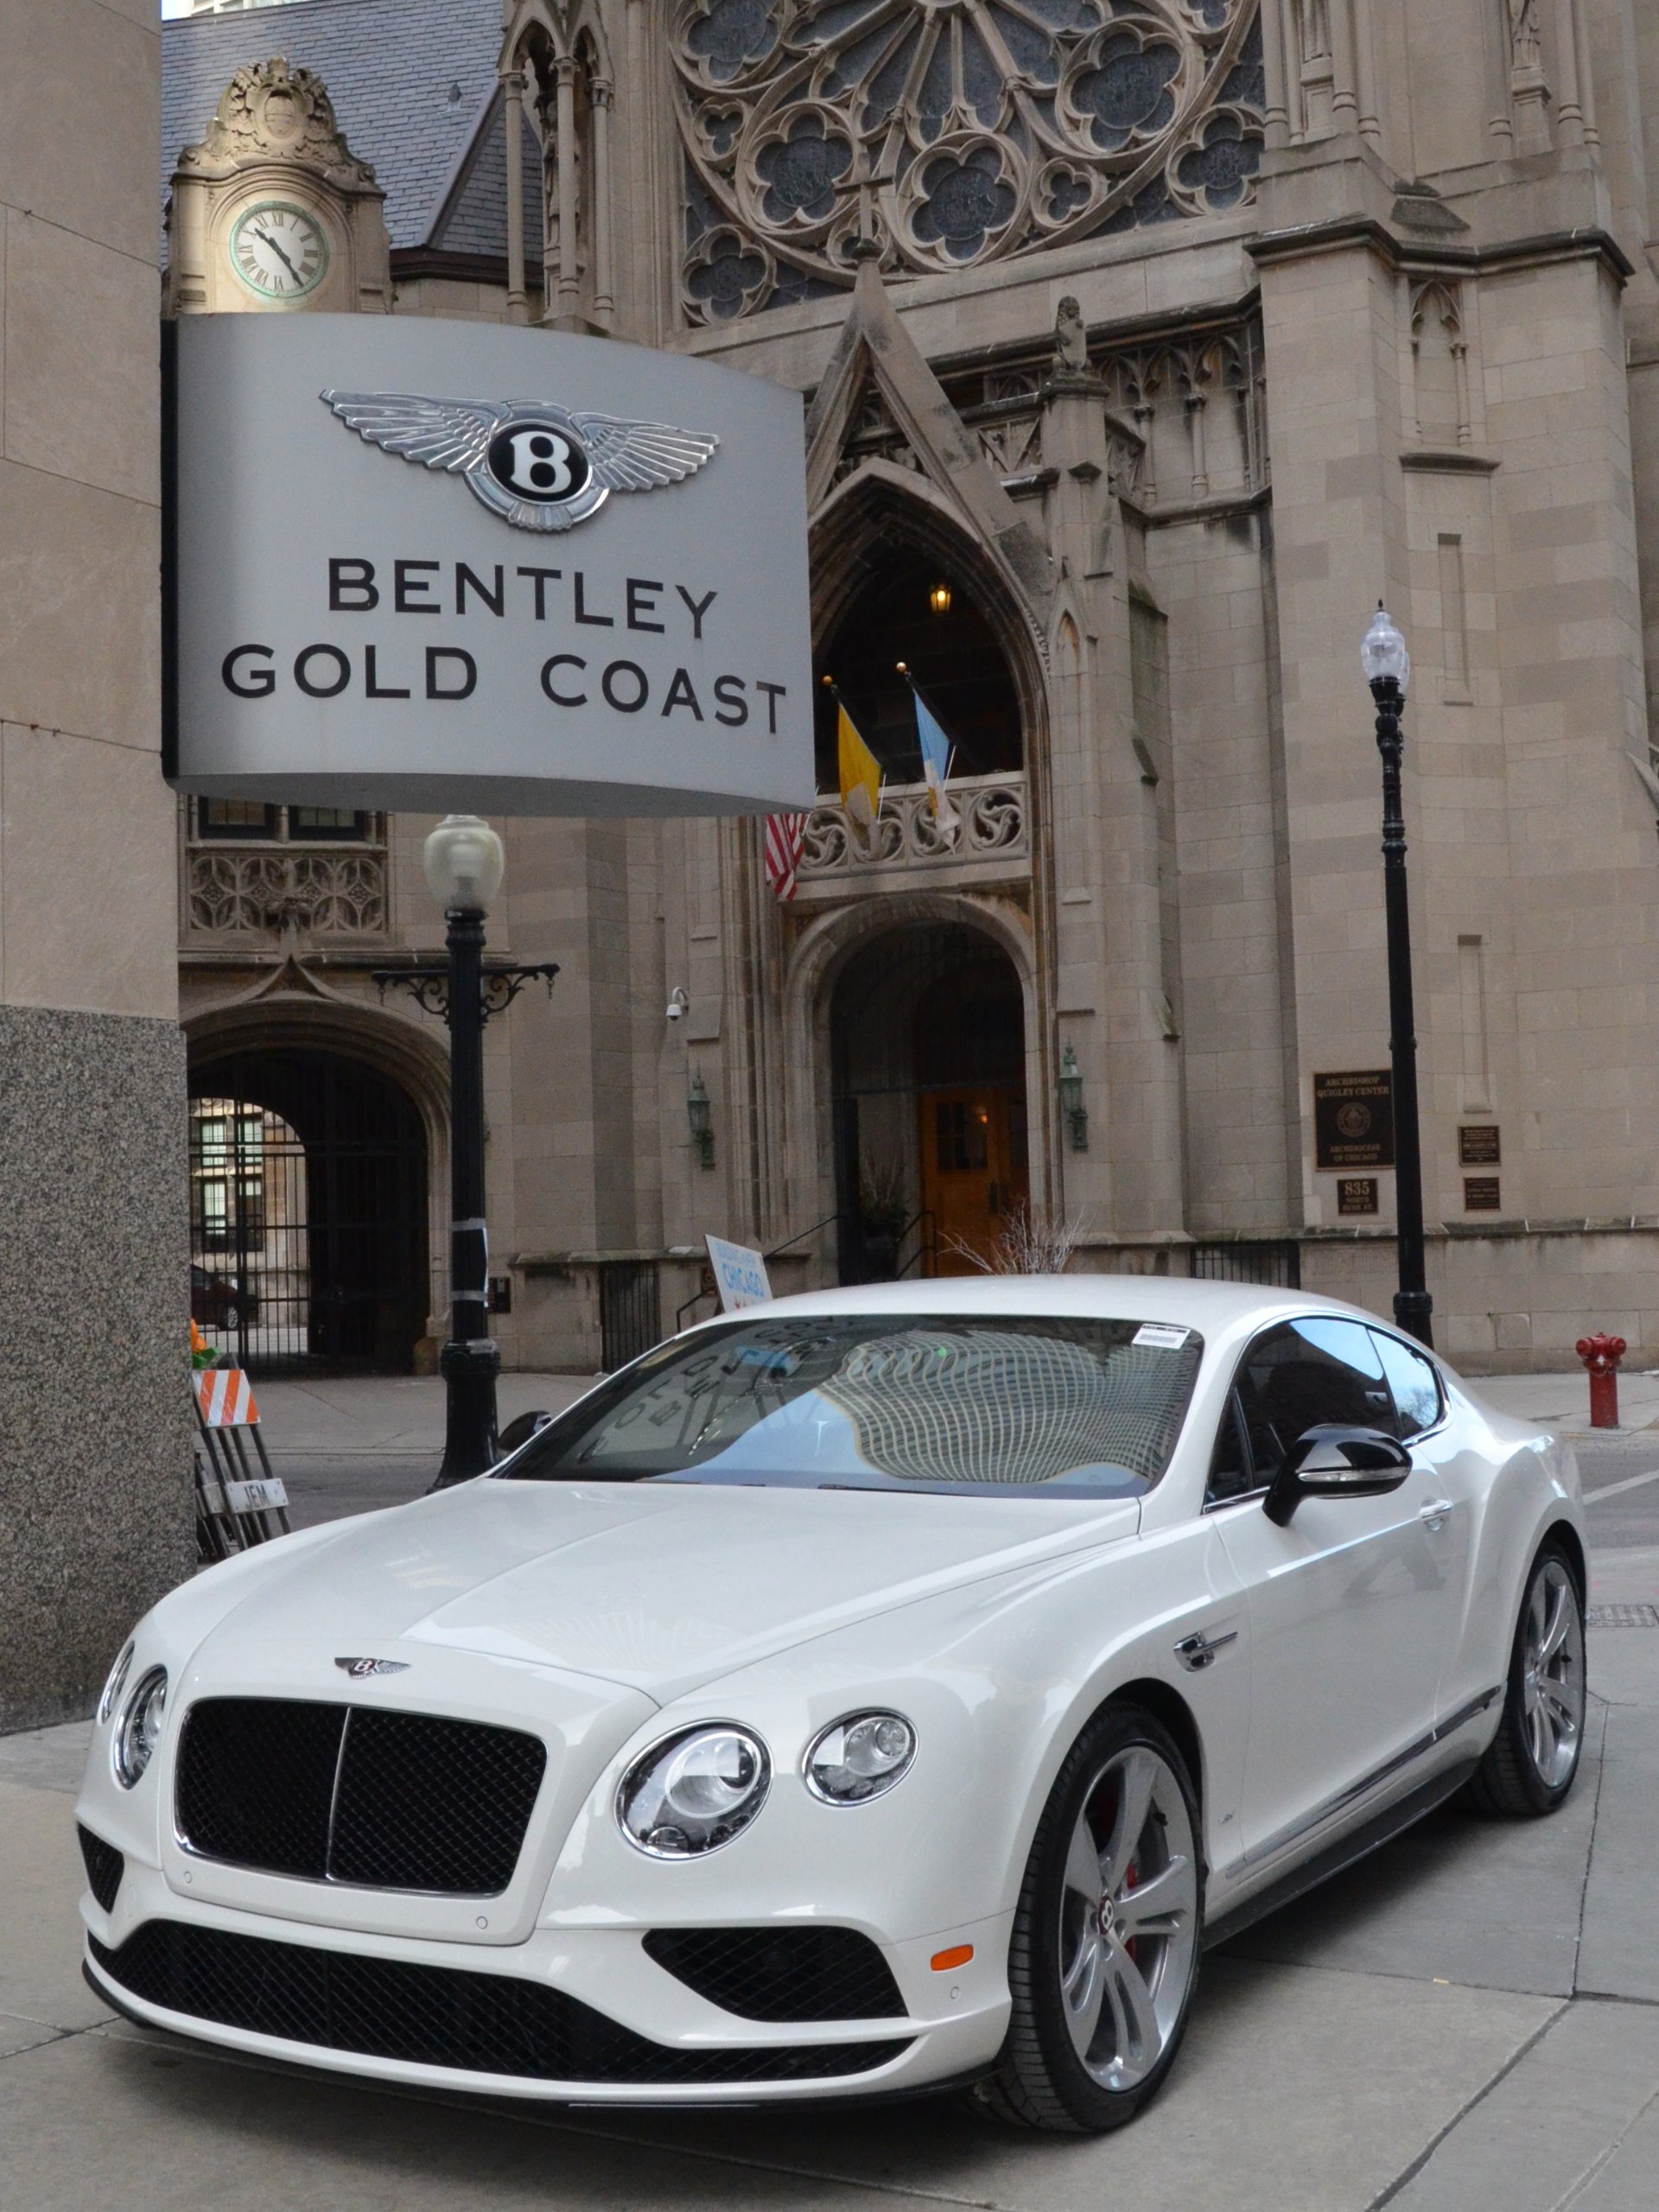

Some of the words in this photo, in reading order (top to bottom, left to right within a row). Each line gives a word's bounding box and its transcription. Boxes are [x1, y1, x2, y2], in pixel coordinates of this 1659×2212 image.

[510, 432, 572, 493] B
[328, 558, 717, 639] BENTLEY
[221, 644, 477, 701] GOLD
[540, 654, 786, 734] COAST
[1317, 1089, 1353, 1098] QUIGLEY
[1355, 1086, 1389, 1096] CENTER
[1325, 1077, 1380, 1086] ARCHBISHOP
[1344, 1181, 1370, 1195] 835
[722, 1262, 765, 1298] CHICAGO
